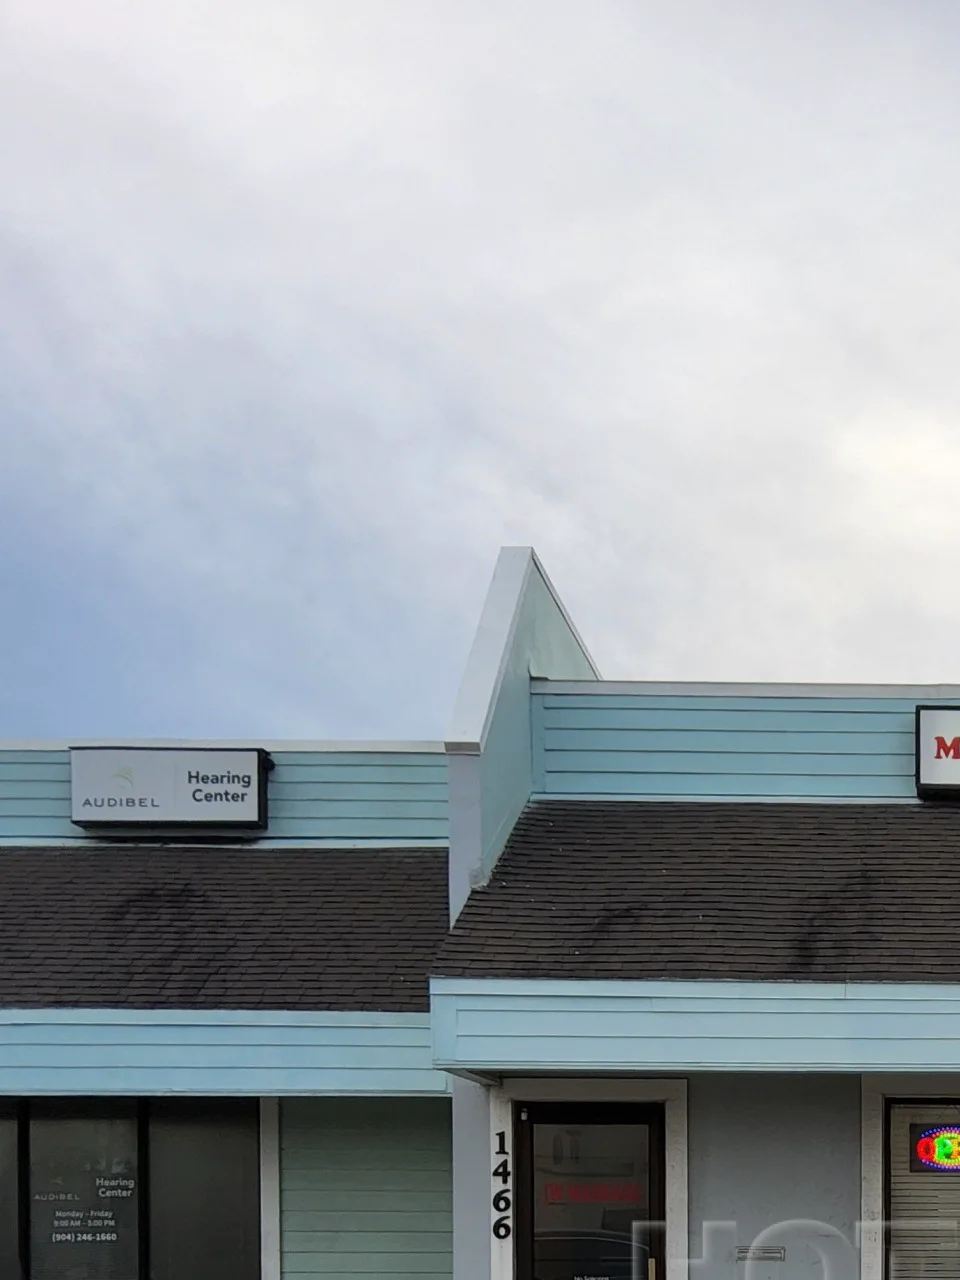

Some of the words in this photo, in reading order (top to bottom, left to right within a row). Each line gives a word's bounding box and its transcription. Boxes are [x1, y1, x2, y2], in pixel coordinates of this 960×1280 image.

[187, 770, 251, 788] Hearing
[192, 788, 248, 802] Center
[82, 798, 160, 808] AUDIBEL
[96, 1178, 135, 1188] Hearing
[492, 1131, 511, 1240] 1466
[98, 1188, 133, 1198] Center
[55, 1210, 84, 1218] Monday
[90, 1210, 113, 1218] Friday
